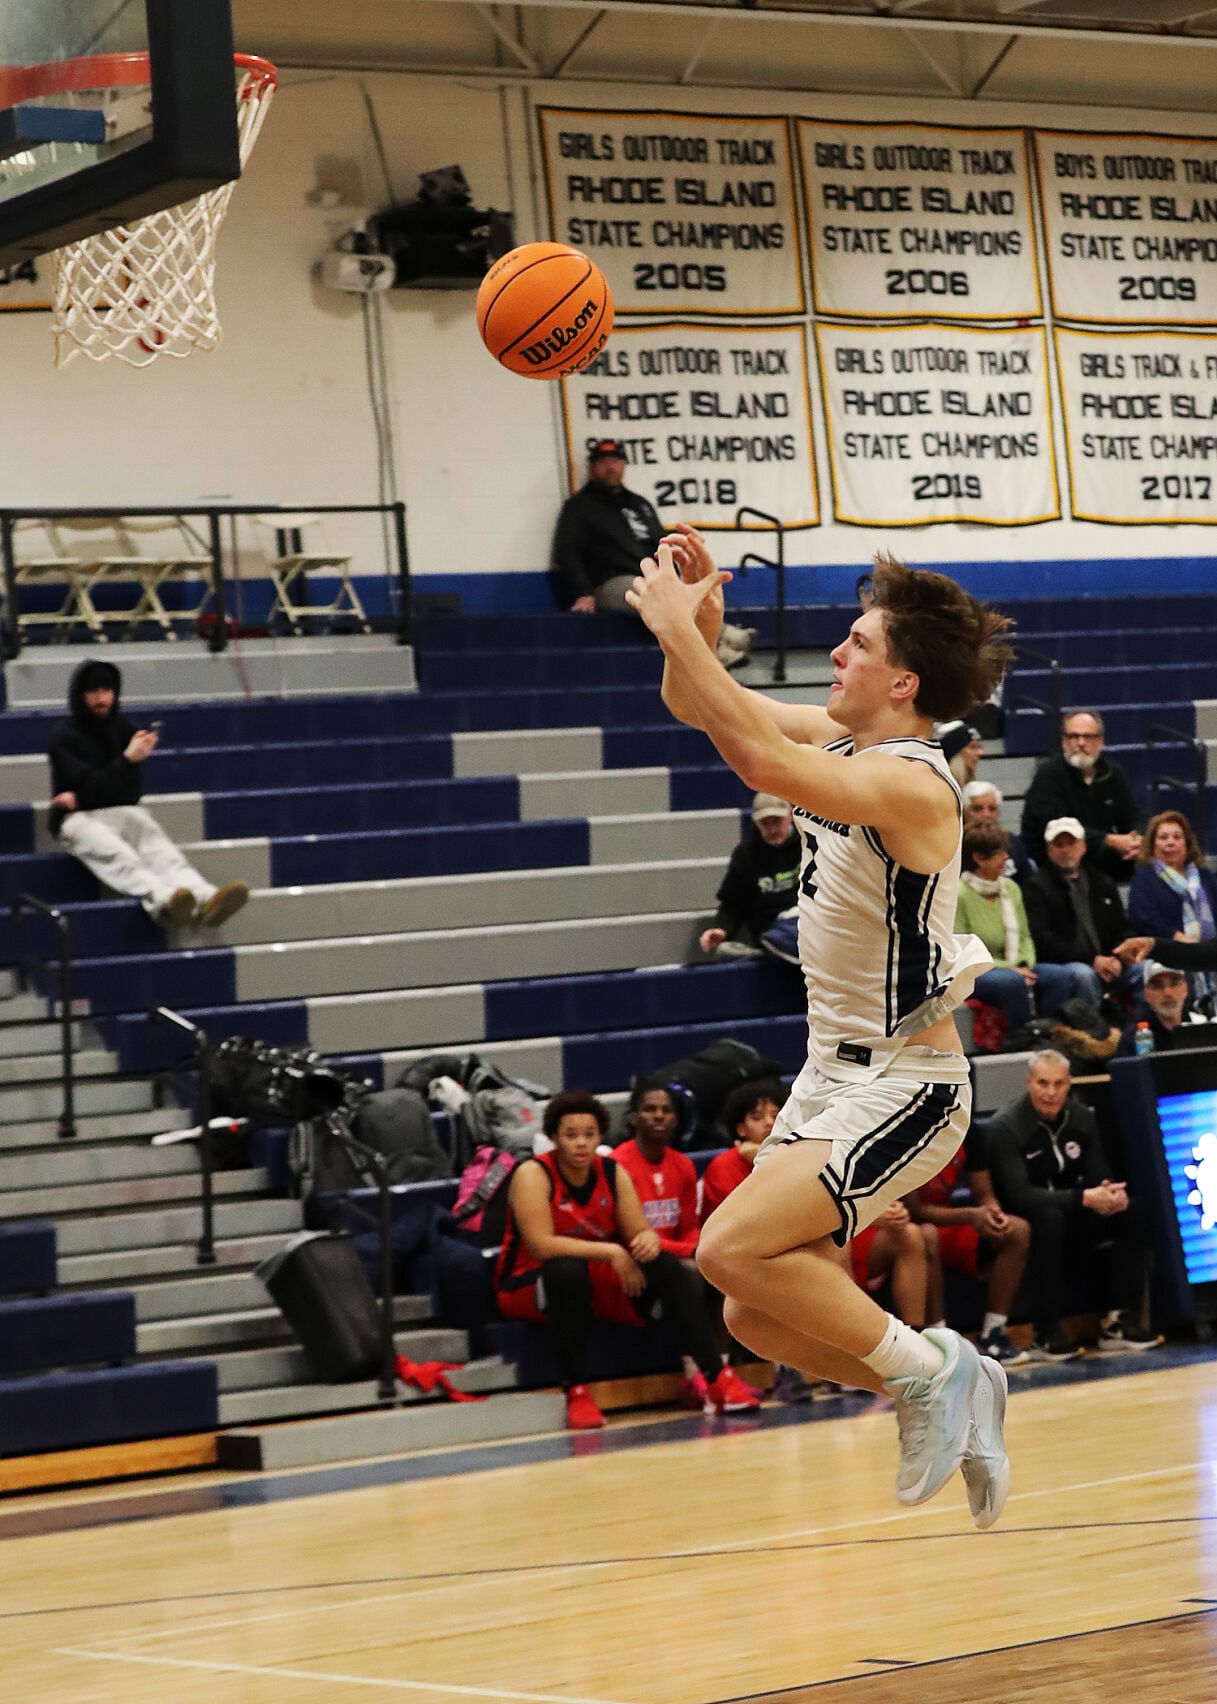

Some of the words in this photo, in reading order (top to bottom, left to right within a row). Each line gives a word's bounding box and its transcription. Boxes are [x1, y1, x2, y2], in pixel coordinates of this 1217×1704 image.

[559, 132, 614, 161] GIRLS
[622, 135, 709, 163] OUTDOOR
[716, 139, 775, 165] TRACK
[815, 142, 865, 171] GIRLS
[873, 145, 952, 172] OUTDOOR
[959, 150, 1015, 175] TRACK
[1054, 152, 1096, 179] BOYS
[1103, 155, 1176, 181] OUTDOOR
[568, 175, 666, 204] RHODE
[675, 178, 776, 208] ISLAND
[822, 184, 912, 212] RHODE
[921, 186, 1014, 215] ISLAND
[1060, 192, 1142, 220] RHODE
[568, 218, 643, 247] STATE
[652, 221, 784, 250] CHAMPIONS
[823, 225, 892, 253] STATE
[900, 228, 1021, 256] CHAMPIONS
[1061, 232, 1125, 261] STATE
[634, 263, 726, 291] 2005
[885, 269, 969, 296] 2006
[1119, 276, 1196, 301] 2009
[519, 300, 599, 365] Wilson
[639, 347, 720, 376] OUTDOOR
[730, 350, 789, 375] TRACK
[835, 348, 884, 374] GIRLS
[892, 347, 968, 374] OUTDOOR
[976, 350, 1031, 375] TRACK
[1081, 353, 1124, 378] GIRLS
[1132, 354, 1182, 378] TRACK
[586, 392, 680, 420] RHODE
[690, 391, 788, 418] ISLAND
[843, 390, 932, 416] RHODE
[941, 390, 1031, 417] ISLAND
[1082, 393, 1162, 419] RHODE
[667, 435, 795, 462] CHAMPIONS
[844, 432, 911, 459] STATE
[922, 433, 1038, 459] CHAMPIONS
[1083, 434, 1142, 460] STATE
[654, 479, 737, 506] 2018
[912, 474, 981, 500] 2019
[1141, 475, 1211, 500] 2017
